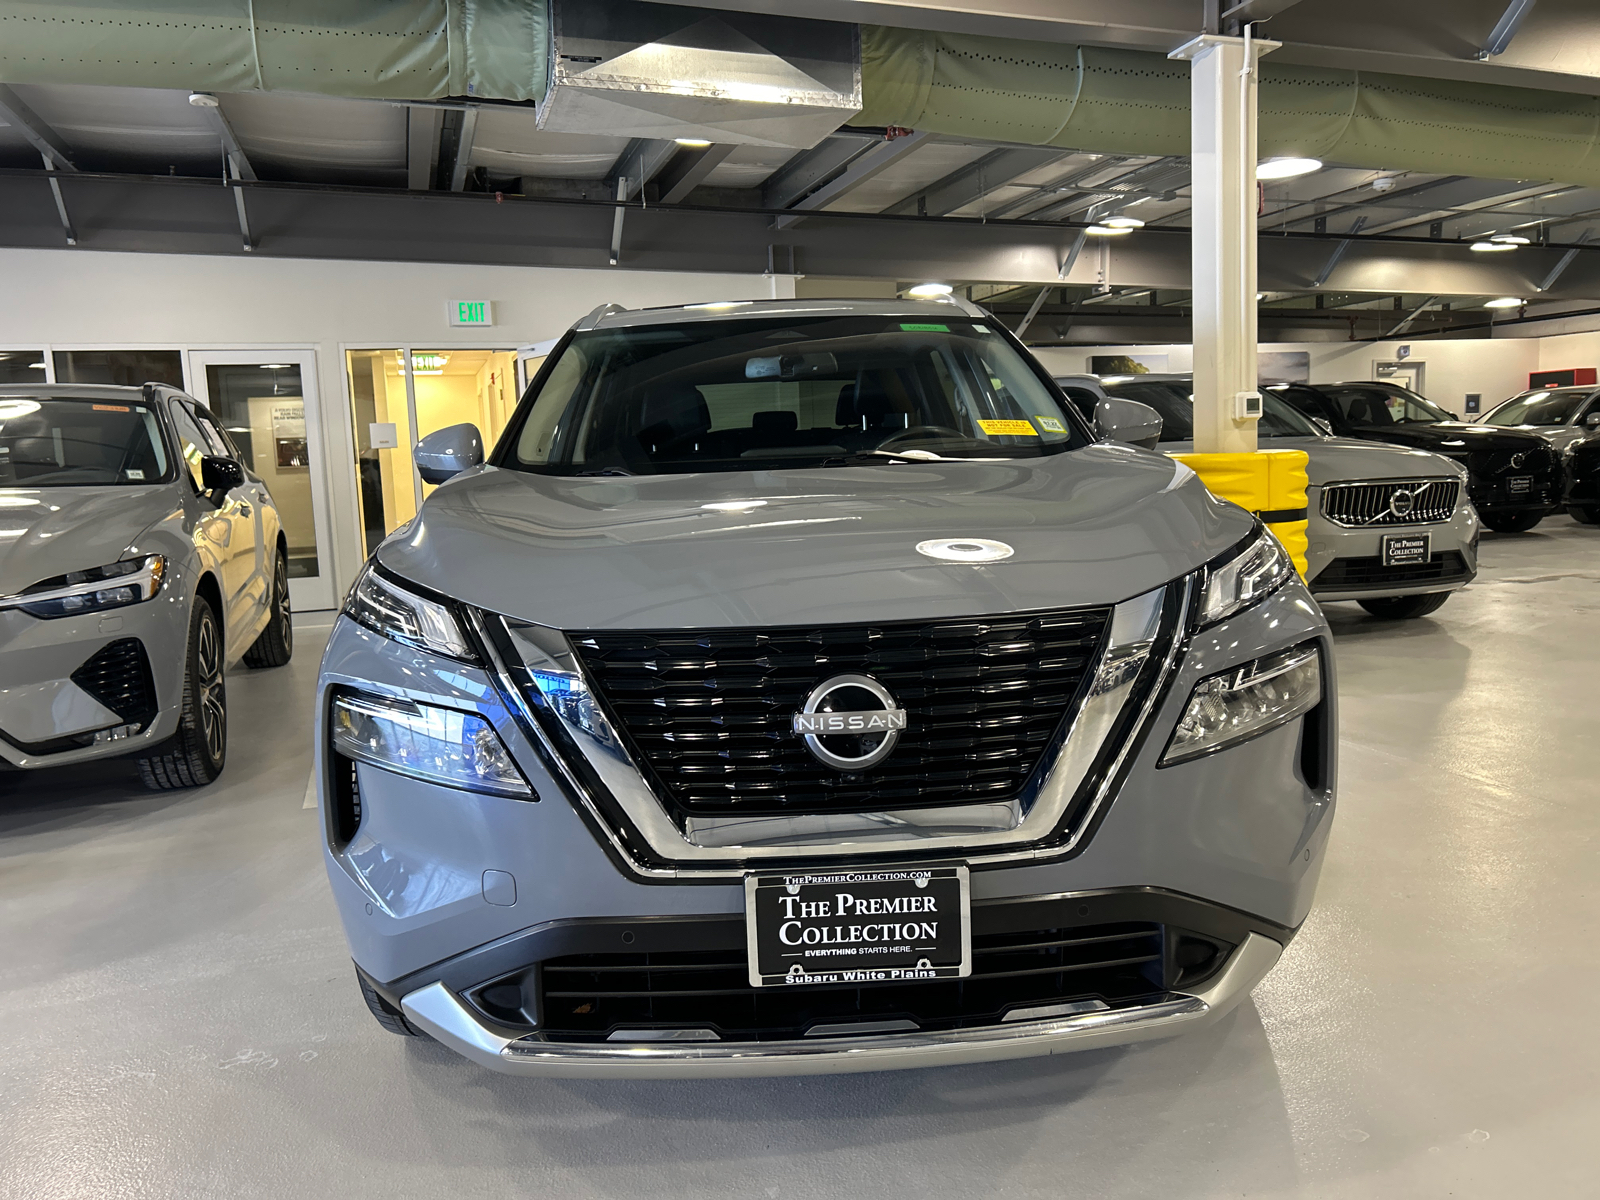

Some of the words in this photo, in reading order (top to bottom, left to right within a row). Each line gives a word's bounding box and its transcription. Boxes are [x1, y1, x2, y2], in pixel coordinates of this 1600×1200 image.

[458, 302, 485, 322] EXIT
[415, 355, 436, 371] EXIT
[1389, 541, 1402, 549] THE
[1402, 540, 1424, 548] PREMIER
[1389, 547, 1424, 556] COLLECTION
[798, 713, 904, 731] NISSAN
[778, 895, 831, 919] THE
[835, 893, 938, 916] PREMIER
[779, 921, 938, 946] COLLECTION
[804, 948, 857, 957] EVERYTHING
[858, 946, 888, 955] STARTS
[889, 945, 913, 954] HERE.
[785, 974, 838, 984] Subaru
[843, 970, 886, 981] White
[891, 969, 937, 979] Plains
